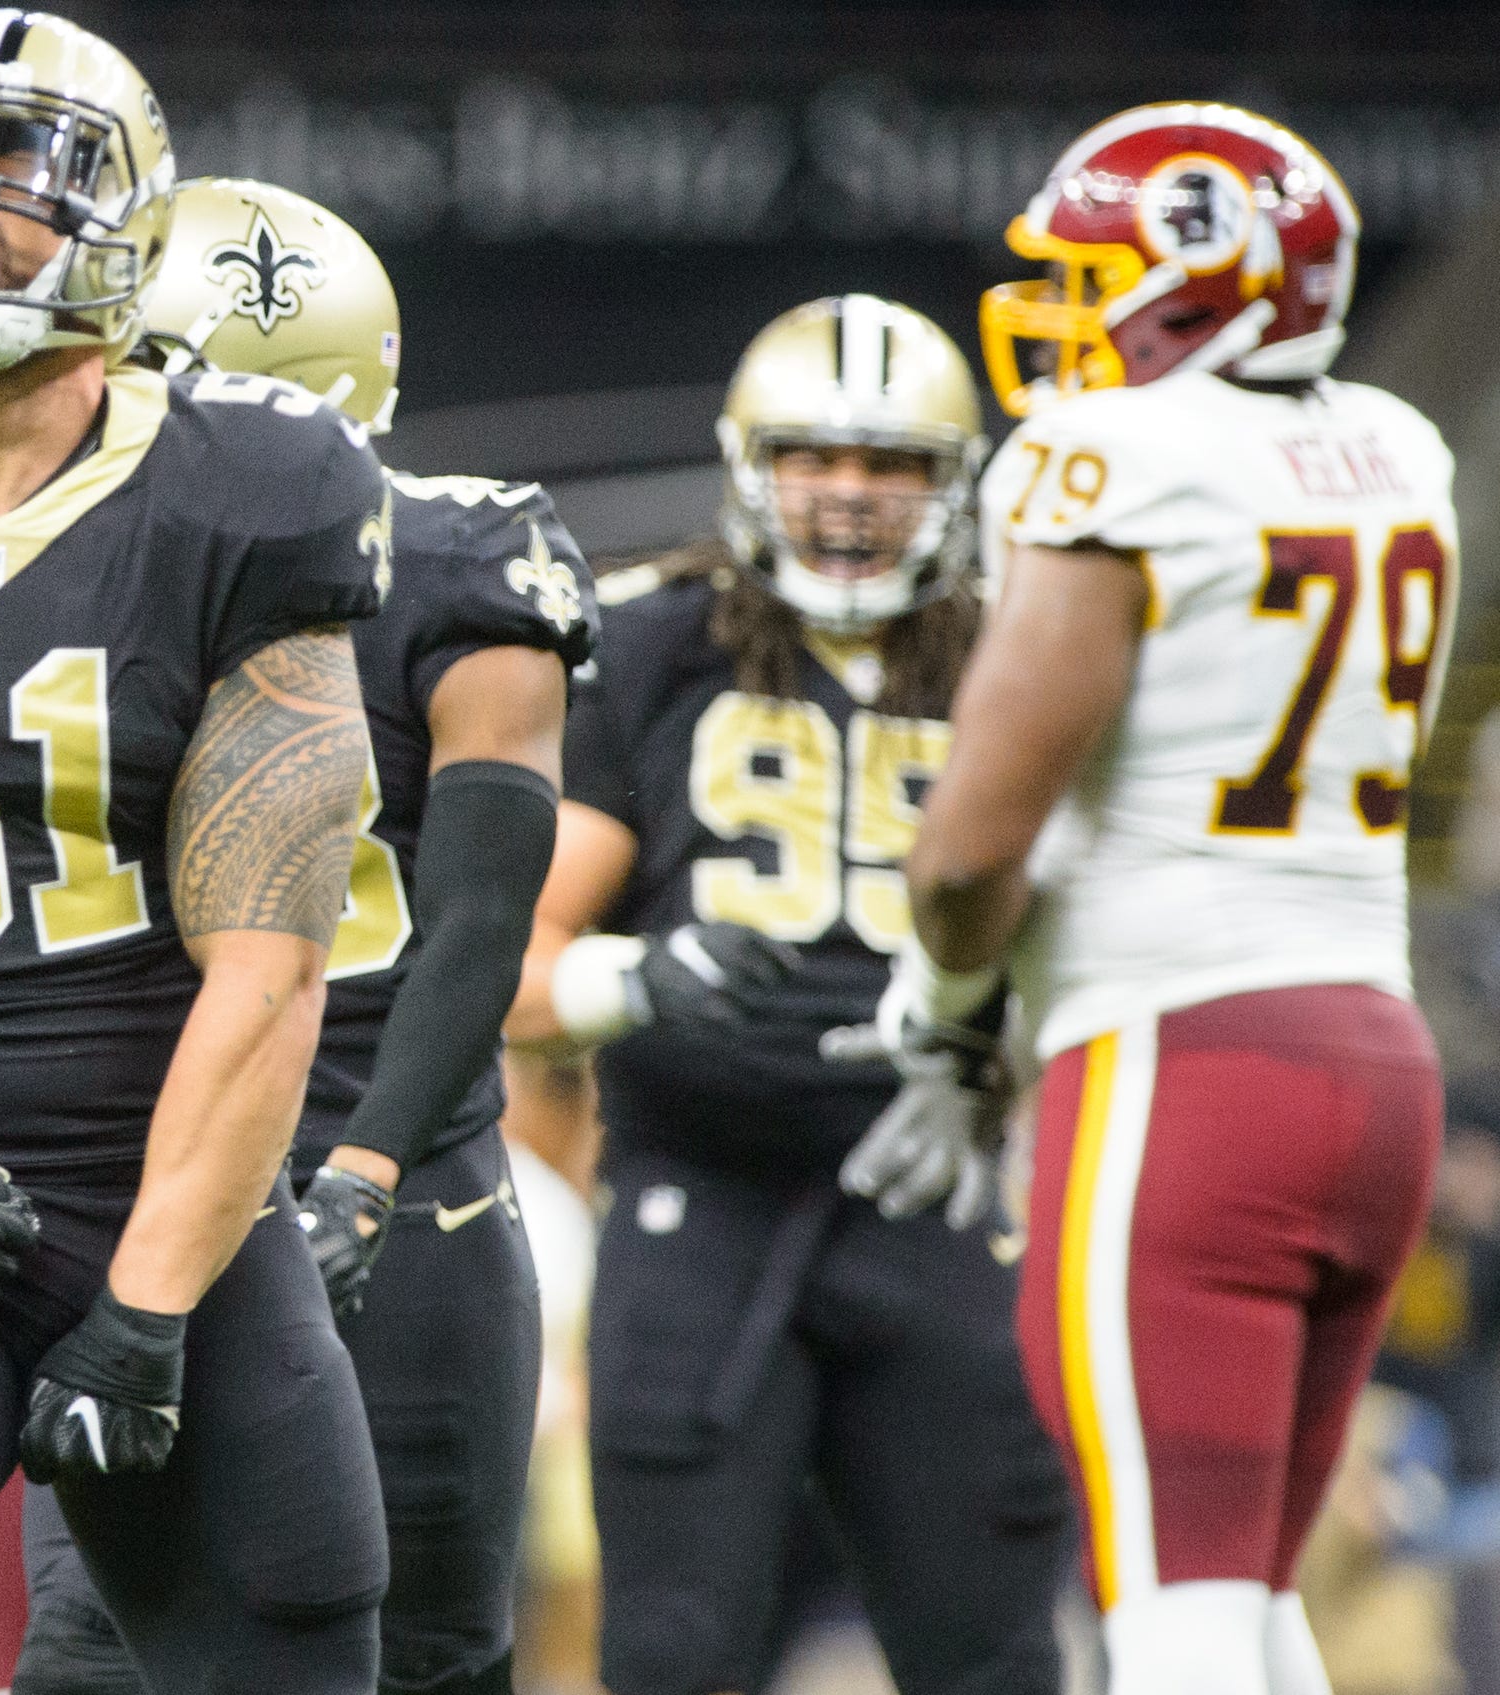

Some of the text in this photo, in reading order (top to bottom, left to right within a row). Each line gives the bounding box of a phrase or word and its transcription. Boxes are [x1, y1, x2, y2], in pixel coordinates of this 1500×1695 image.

[1008, 440, 1109, 524] 79
[1207, 520, 1454, 837] 79
[689, 690, 957, 956] 95
